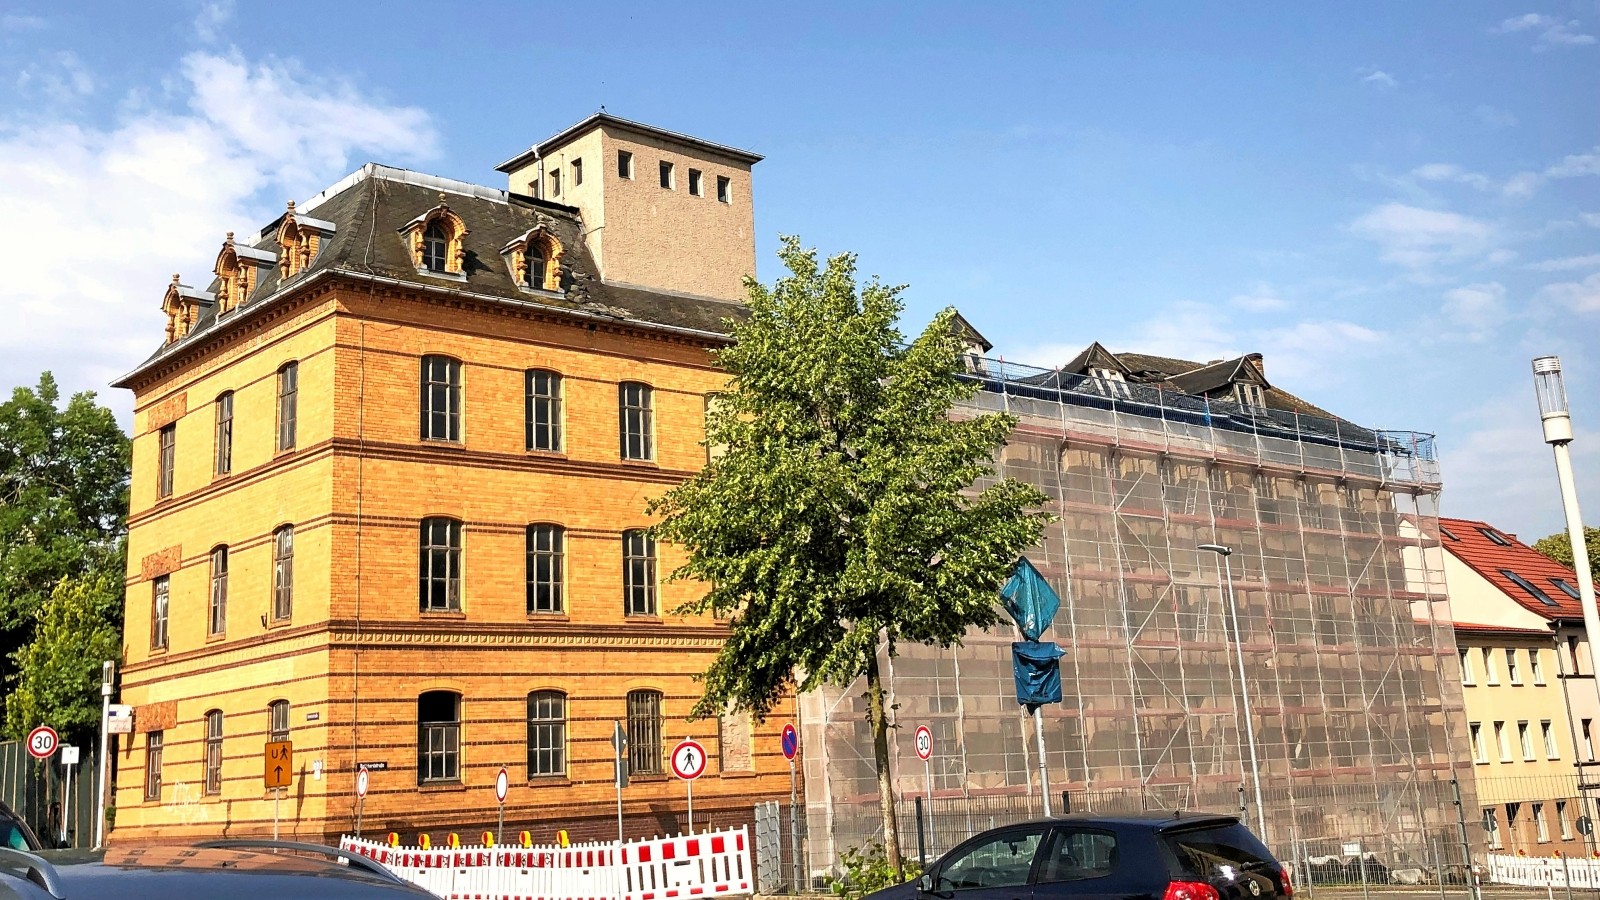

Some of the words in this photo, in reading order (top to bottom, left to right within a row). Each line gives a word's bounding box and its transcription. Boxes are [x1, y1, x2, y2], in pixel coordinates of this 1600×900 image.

[34, 735, 52, 750] 30
[918, 735, 929, 751] 30
[271, 748, 279, 759] U
